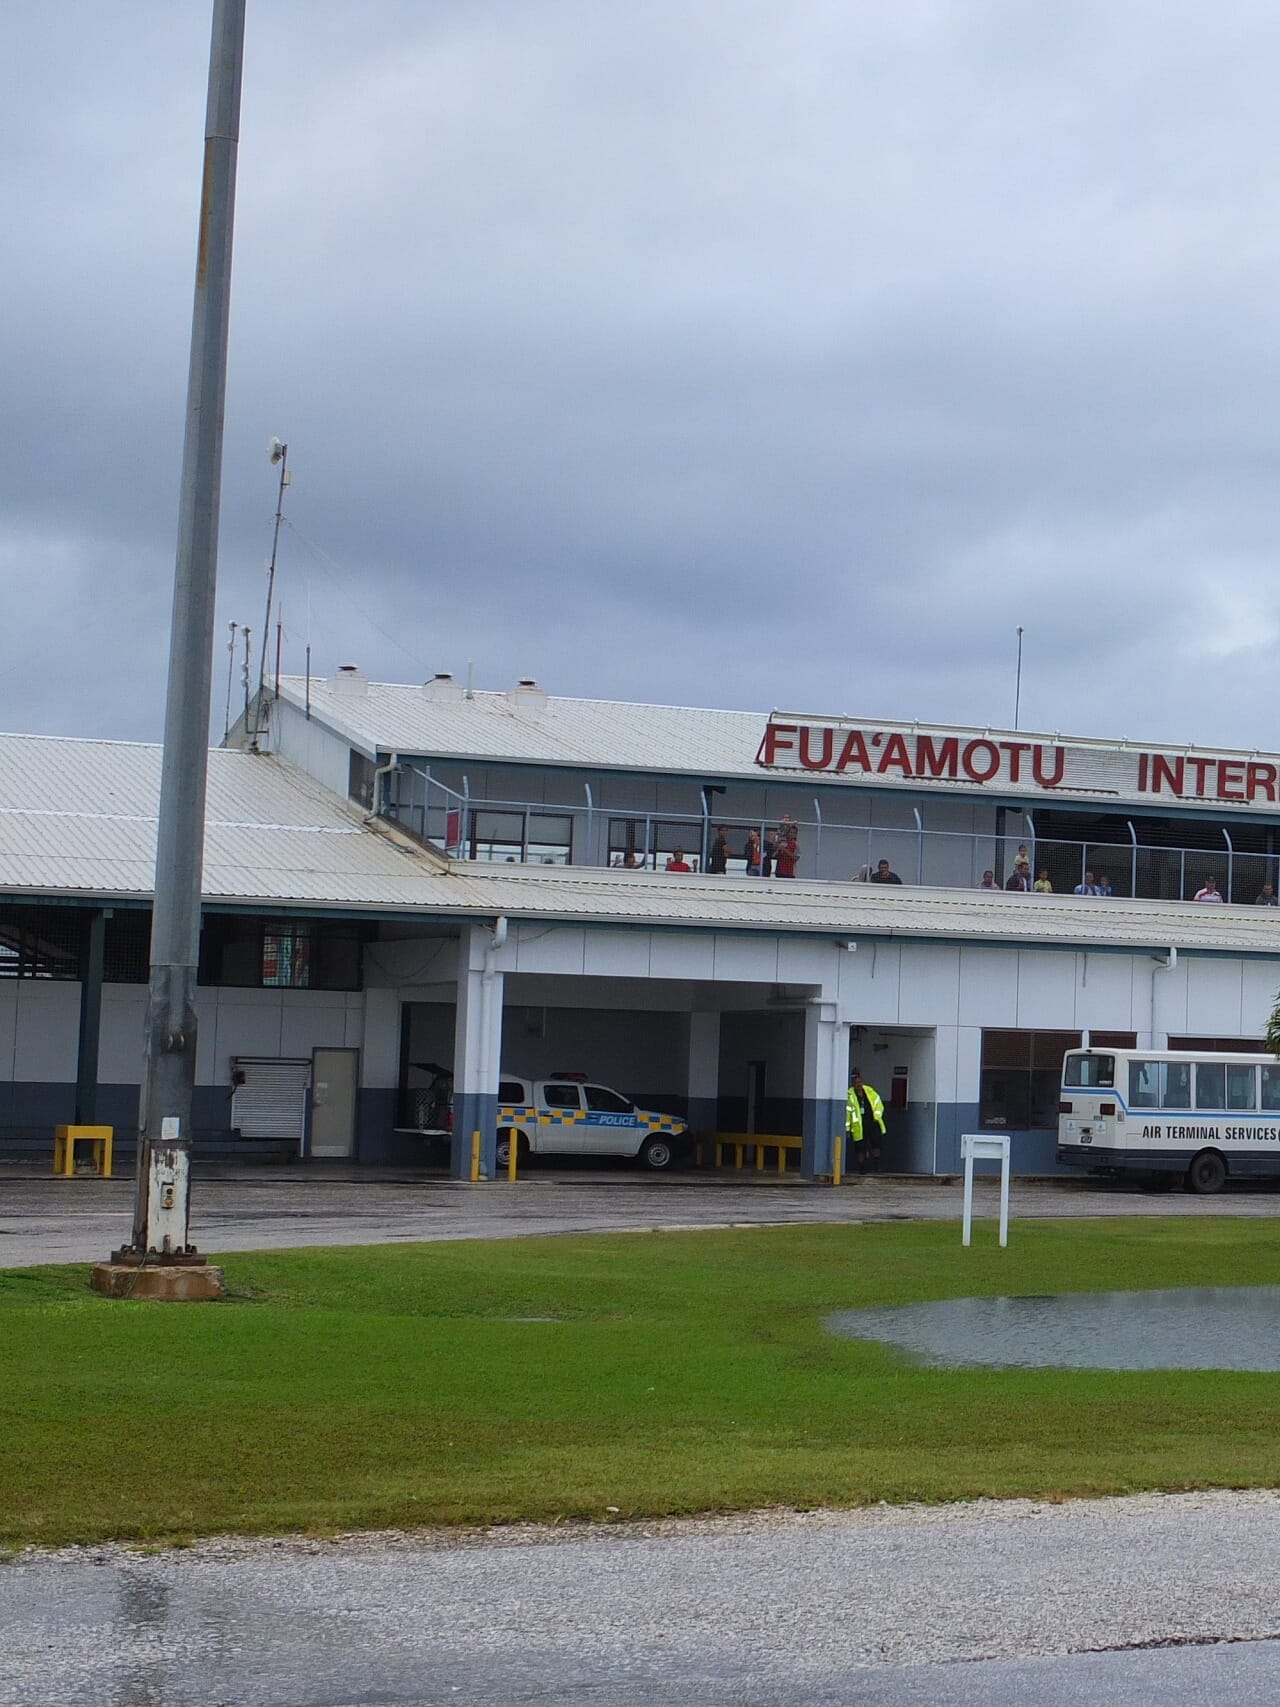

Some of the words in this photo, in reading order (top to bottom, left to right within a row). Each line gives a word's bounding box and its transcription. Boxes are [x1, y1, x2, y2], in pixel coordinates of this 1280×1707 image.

[599, 1115, 636, 1126] POLICE
[1142, 1126, 1162, 1139] AIR
[1166, 1126, 1221, 1140] TERMINAL
